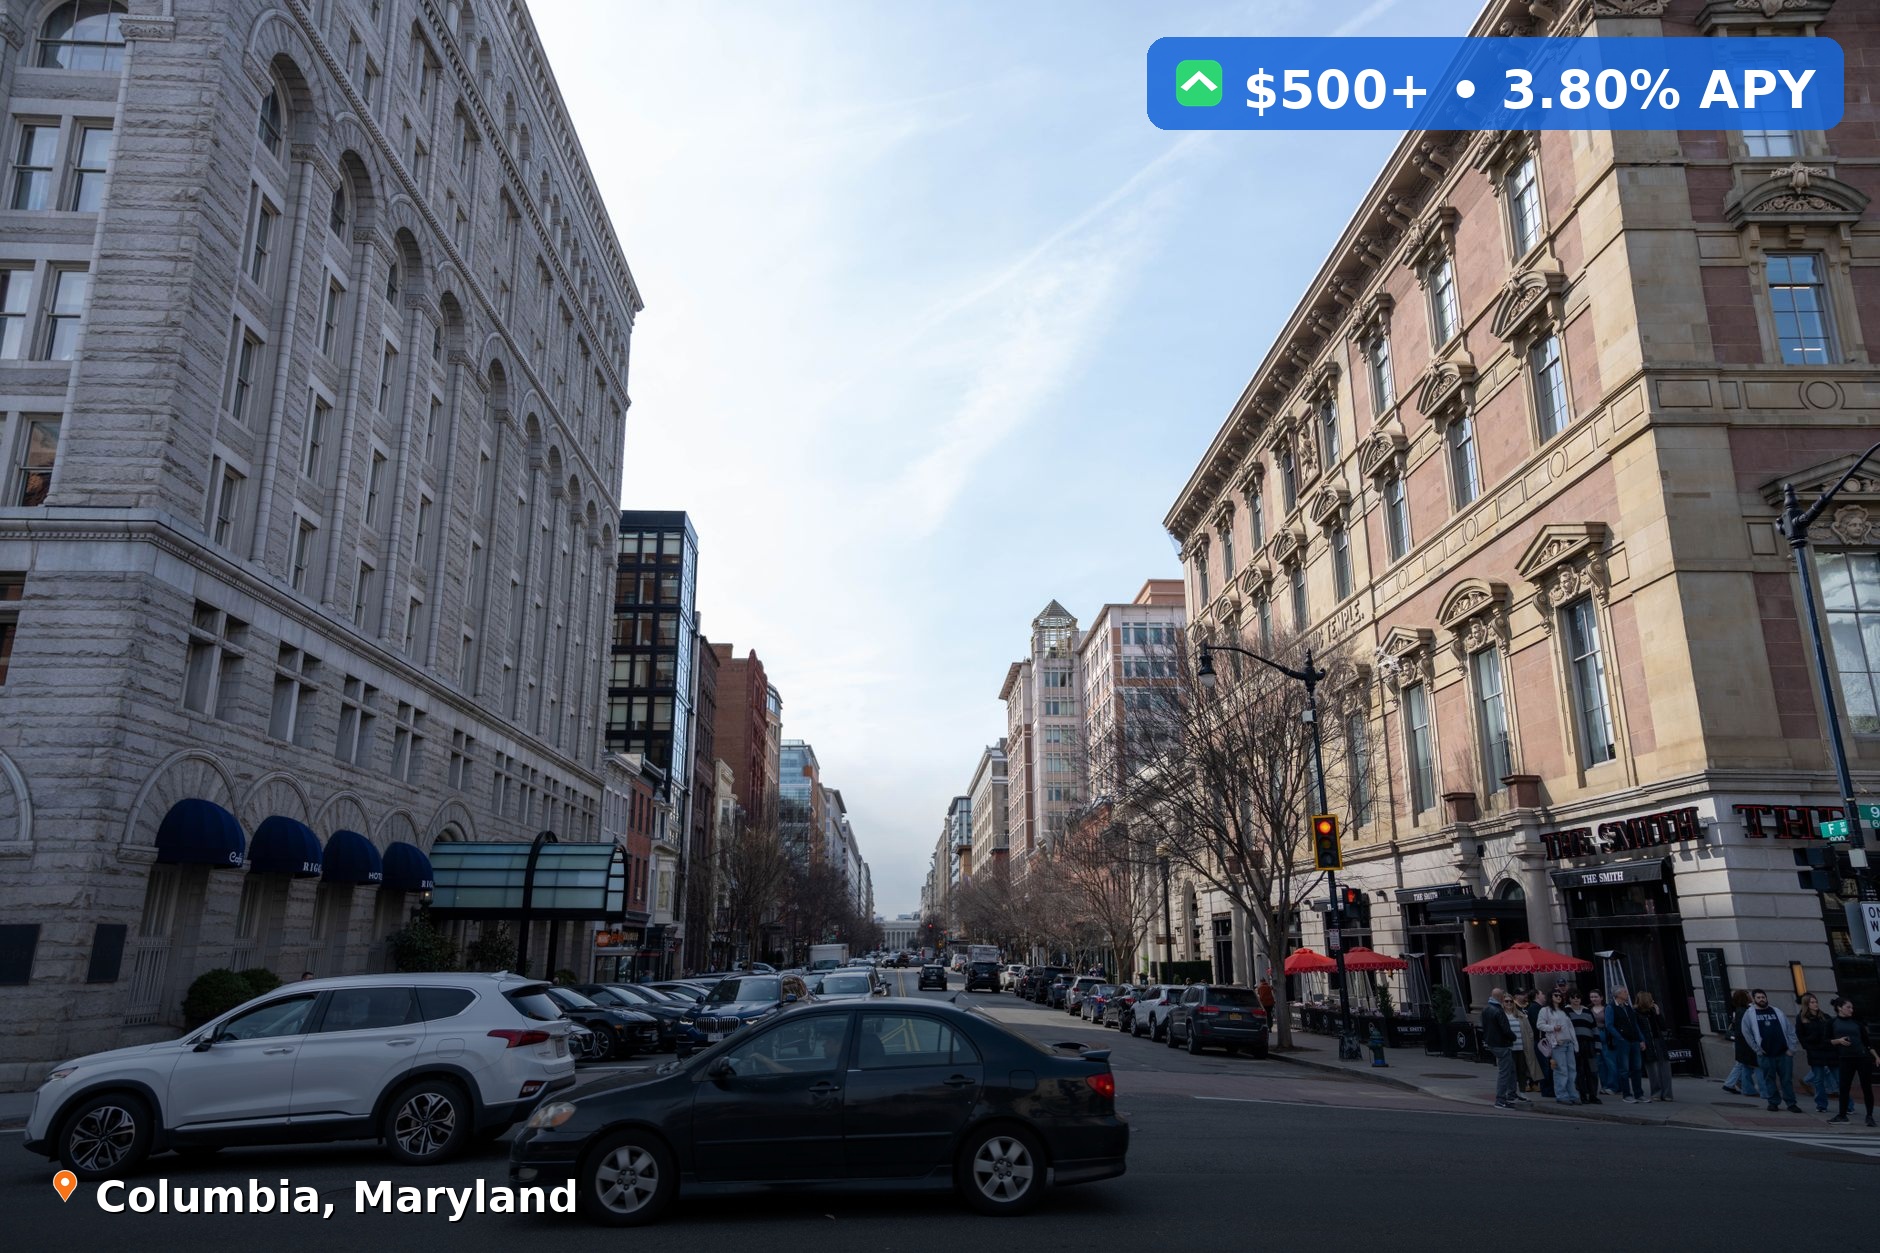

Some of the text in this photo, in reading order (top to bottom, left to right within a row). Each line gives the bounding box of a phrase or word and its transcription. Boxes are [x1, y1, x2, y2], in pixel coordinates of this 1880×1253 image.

[1540, 806, 1704, 860] THE SMITH
[1828, 823, 1834, 835] F
[1581, 871, 1624, 885] THE SMITH
[1668, 1050, 1692, 1060] SMITH
